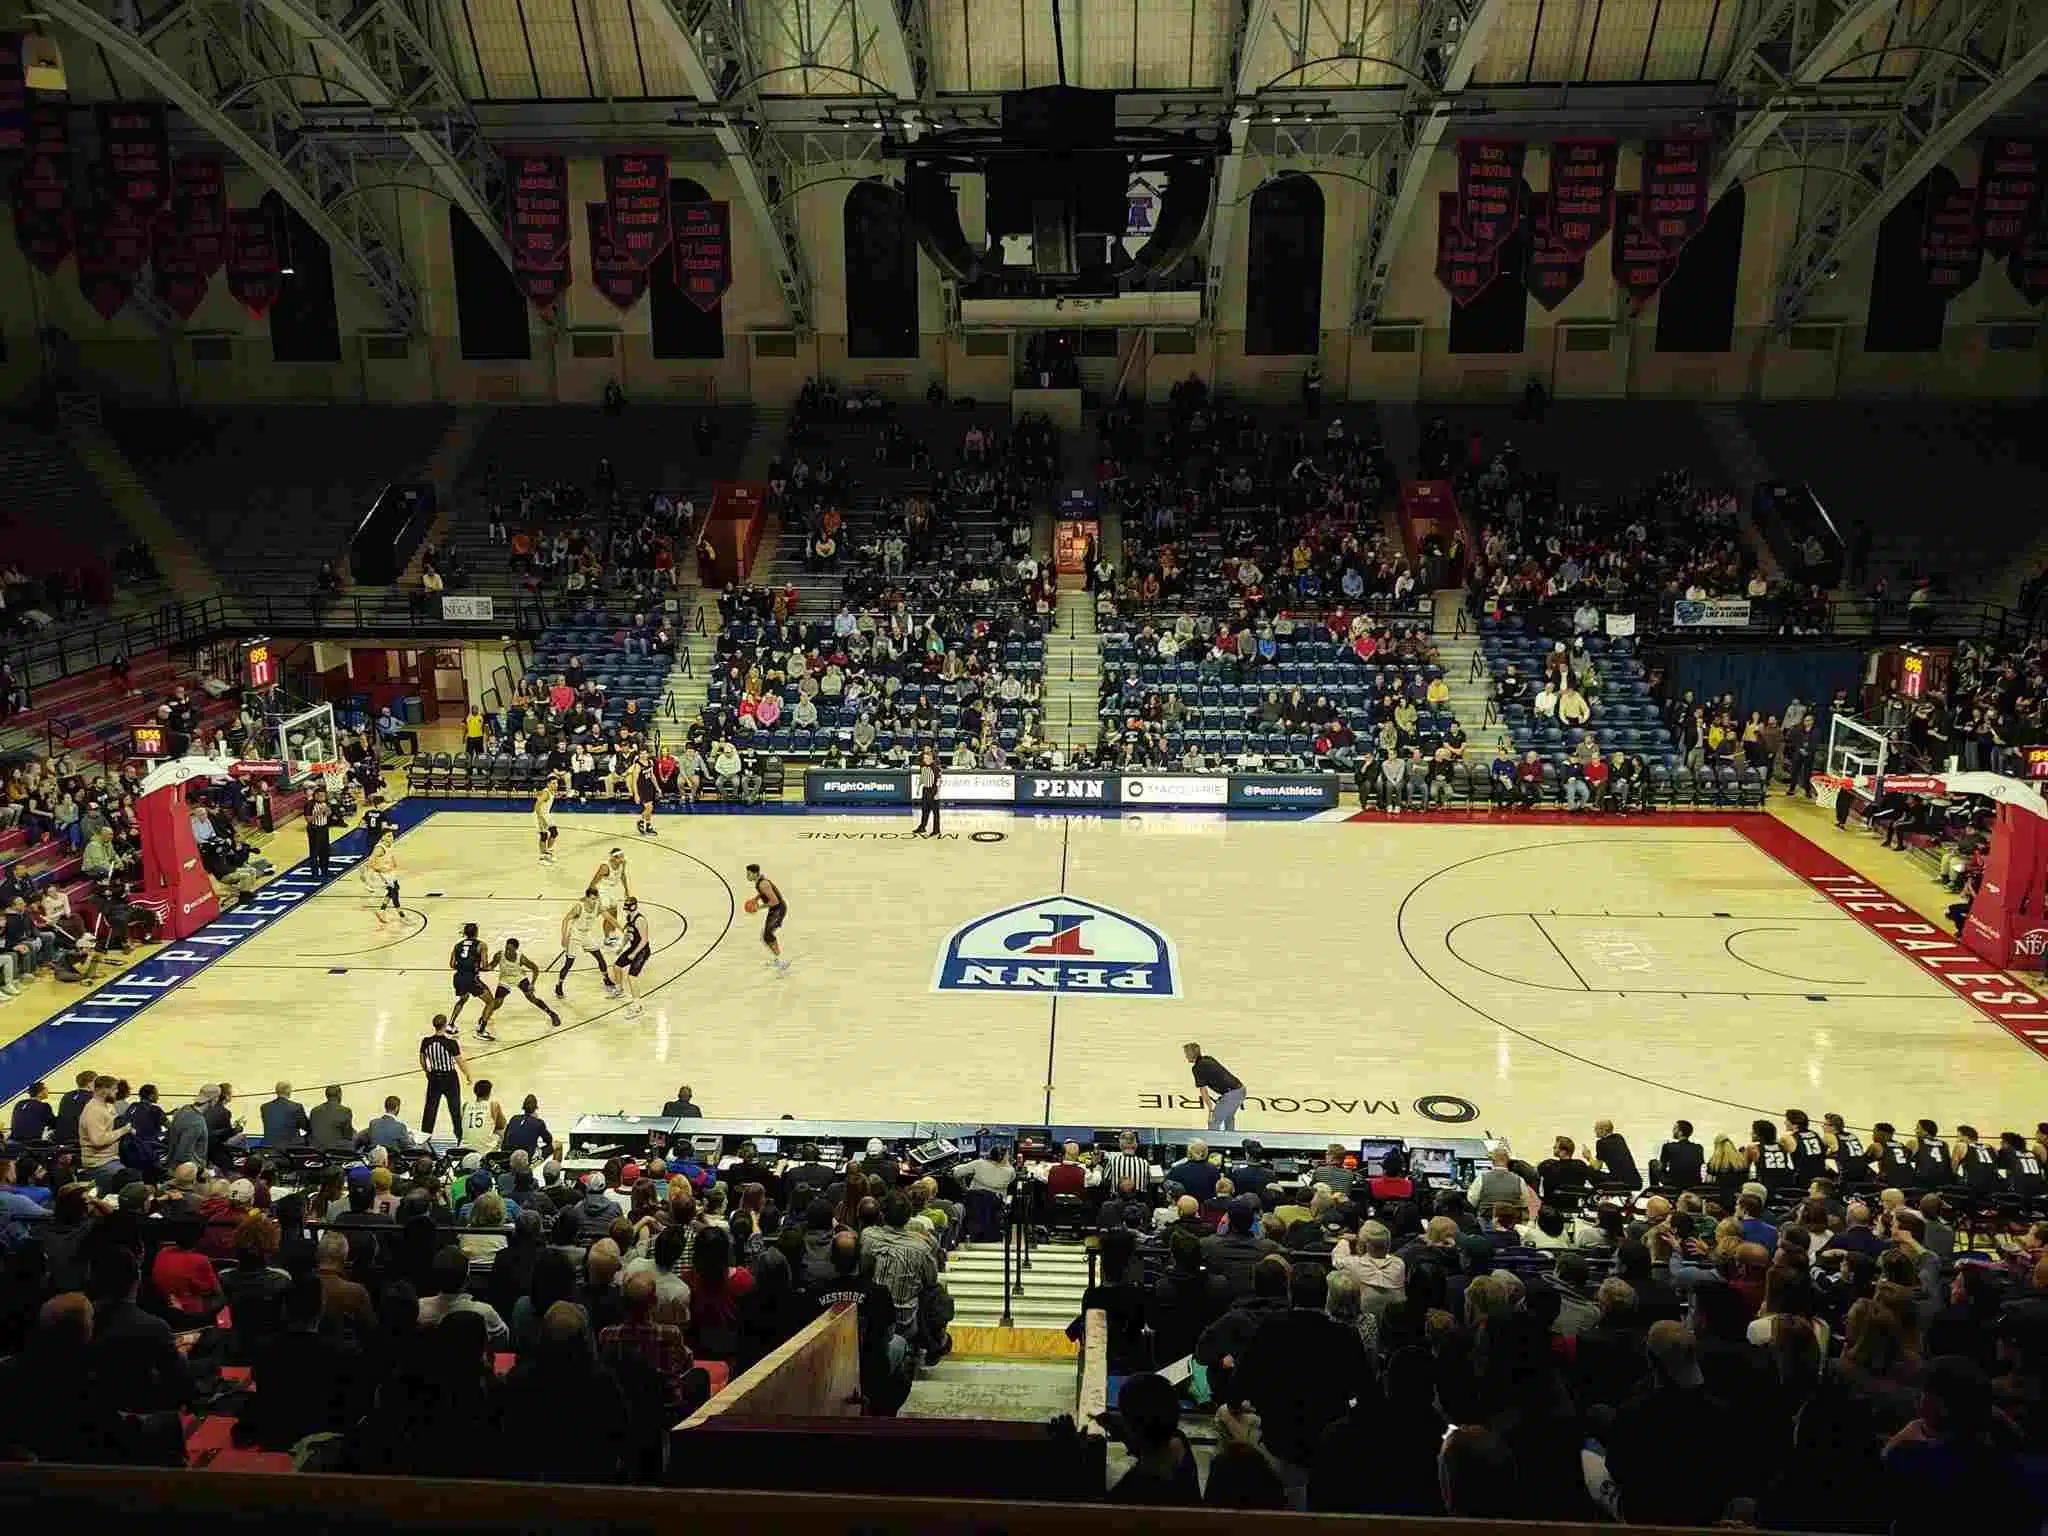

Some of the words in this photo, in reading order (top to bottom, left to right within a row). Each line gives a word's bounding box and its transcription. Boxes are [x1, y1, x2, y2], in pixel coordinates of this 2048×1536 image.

[824, 782, 895, 793] #FightOnPenn
[1033, 779, 1104, 798] PENN
[1243, 784, 1323, 797] @PennAthletics
[1809, 875, 1908, 913] THE
[1003, 913, 1096, 957] P
[956, 965, 1153, 990] PENN
[51, 974, 183, 1028] THE
[468, 1111, 485, 1129] 15
[1803, 1137, 1821, 1156] 13
[1763, 1151, 1786, 1169] 22
